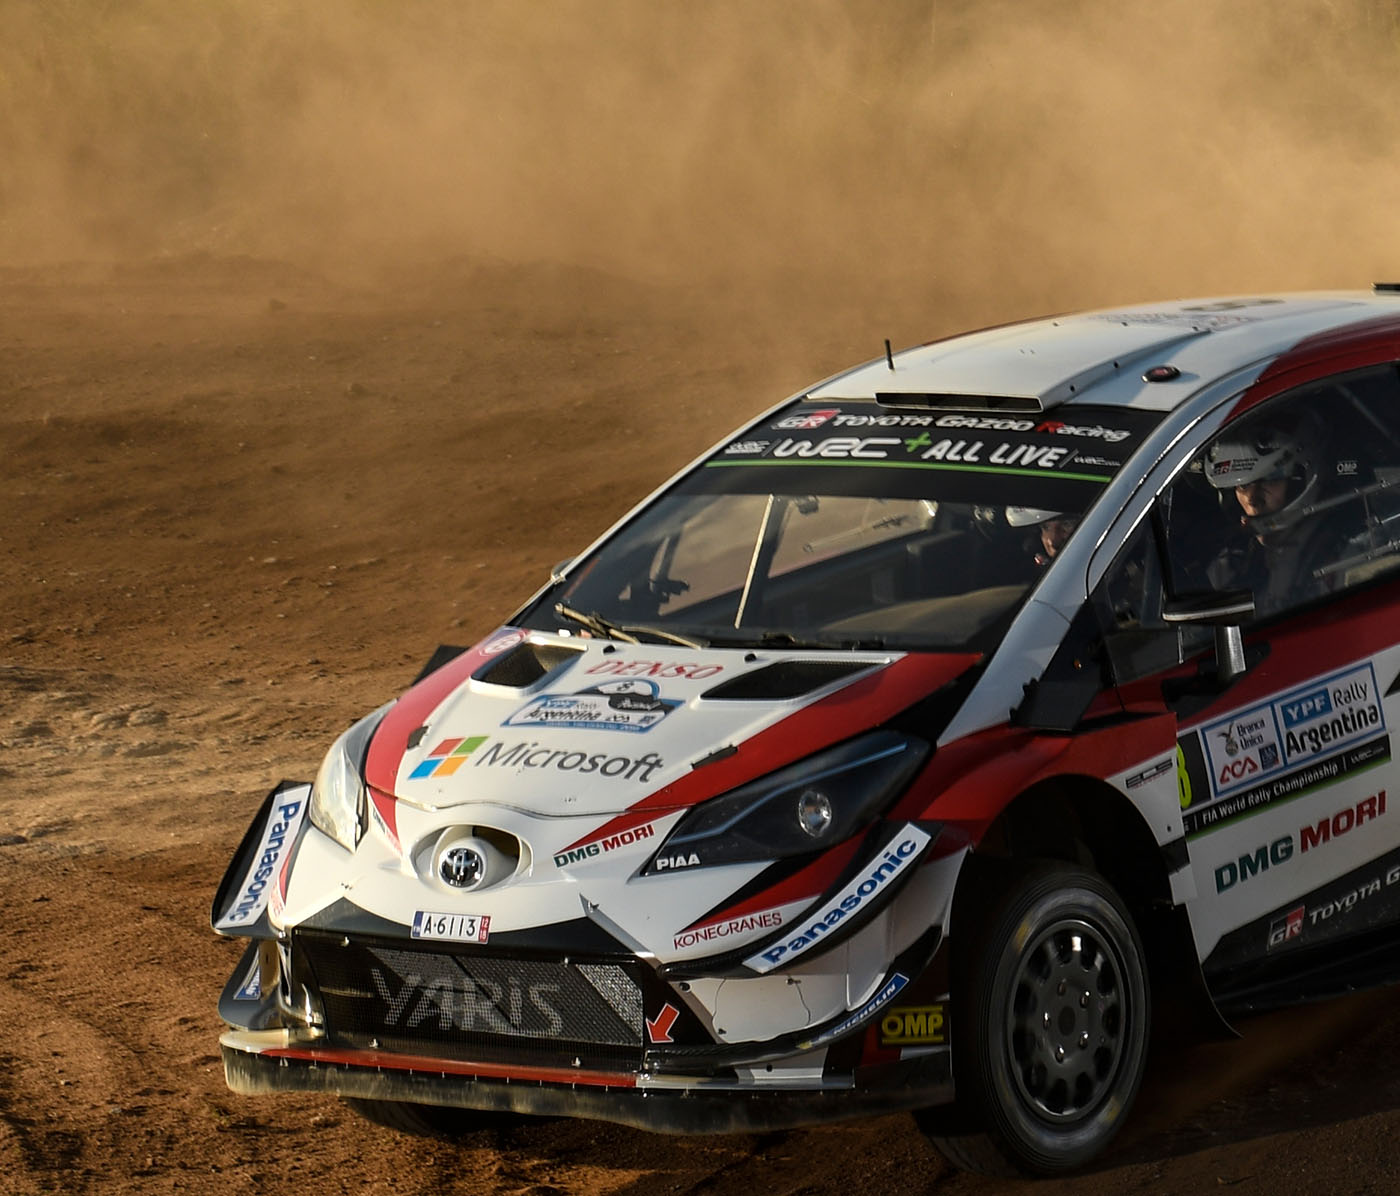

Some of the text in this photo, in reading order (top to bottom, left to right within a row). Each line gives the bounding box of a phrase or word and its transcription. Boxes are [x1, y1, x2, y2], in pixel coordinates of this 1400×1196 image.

[832, 415, 933, 427] TOYOTA
[935, 415, 1035, 431] GAZOO
[1036, 420, 1131, 442] Racing
[921, 439, 984, 462] ALL
[989, 443, 1068, 467] LIVE
[585, 661, 724, 680] DENSO
[1287, 681, 1367, 721] YPF Rally
[1286, 704, 1379, 757] Argentina
[475, 742, 664, 783] Microsoft
[1202, 809, 1218, 825] FIA
[1219, 798, 1245, 818] World
[1248, 789, 1271, 807] Rally
[1273, 764, 1338, 796] Championship
[229, 801, 302, 921] Panasonic
[553, 824, 655, 868] DMG MORI
[656, 853, 701, 871] PIAA
[1214, 790, 1386, 894] DMG MORI
[761, 840, 917, 964] Panasonic
[1309, 880, 1381, 925] TOYOTA
[673, 912, 782, 950] KONECRANES
[881, 1012, 944, 1037] OMP
